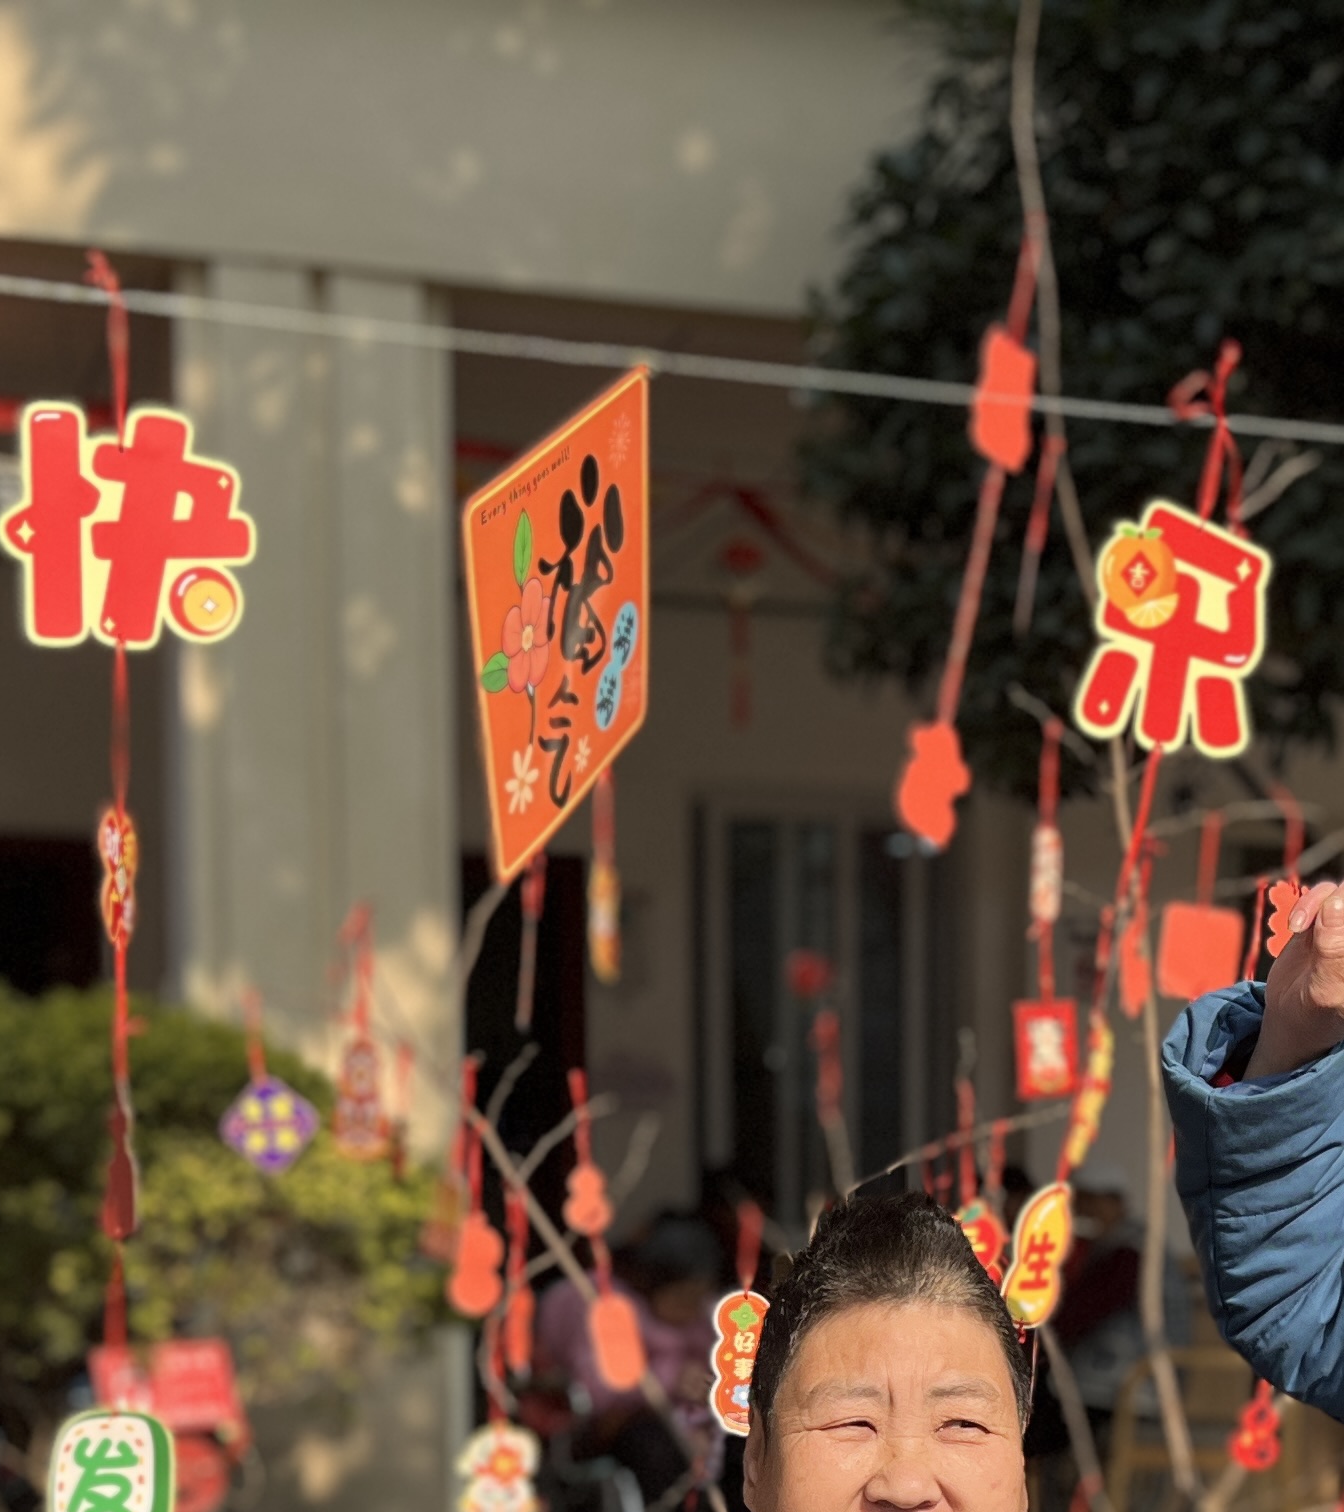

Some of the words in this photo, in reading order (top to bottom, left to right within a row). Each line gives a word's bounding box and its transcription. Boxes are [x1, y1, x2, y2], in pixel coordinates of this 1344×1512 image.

[5, 409, 250, 642] 快
[480, 502, 507, 526] Every
[509, 481, 532, 504] thing
[1082, 507, 1264, 748] 乐
[1017, 1231, 1057, 1290] 生
